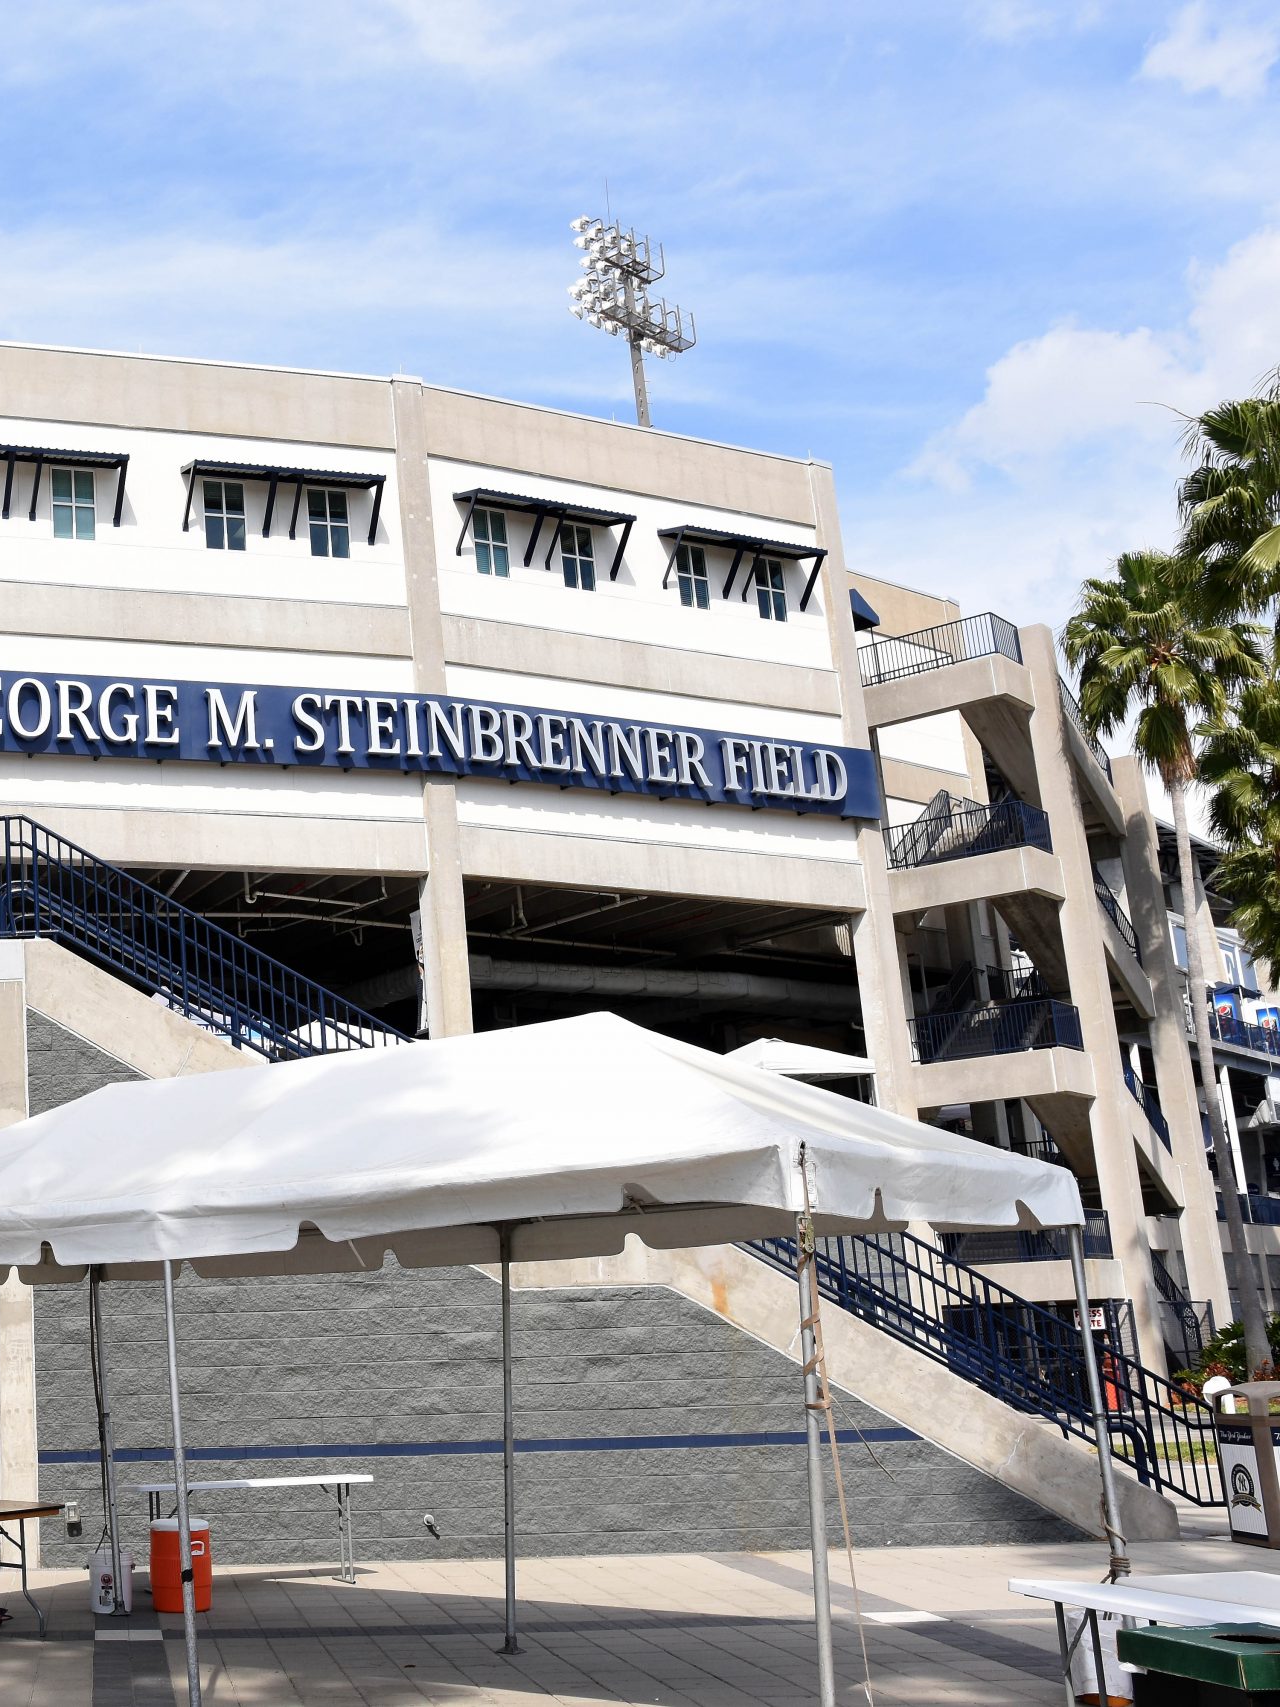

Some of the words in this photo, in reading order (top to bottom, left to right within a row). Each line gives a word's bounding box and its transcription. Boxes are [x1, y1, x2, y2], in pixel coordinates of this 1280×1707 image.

[205, 688, 274, 749] M.
[291, 692, 713, 788] STEINBRENNER
[719, 737, 848, 801] FIELD
